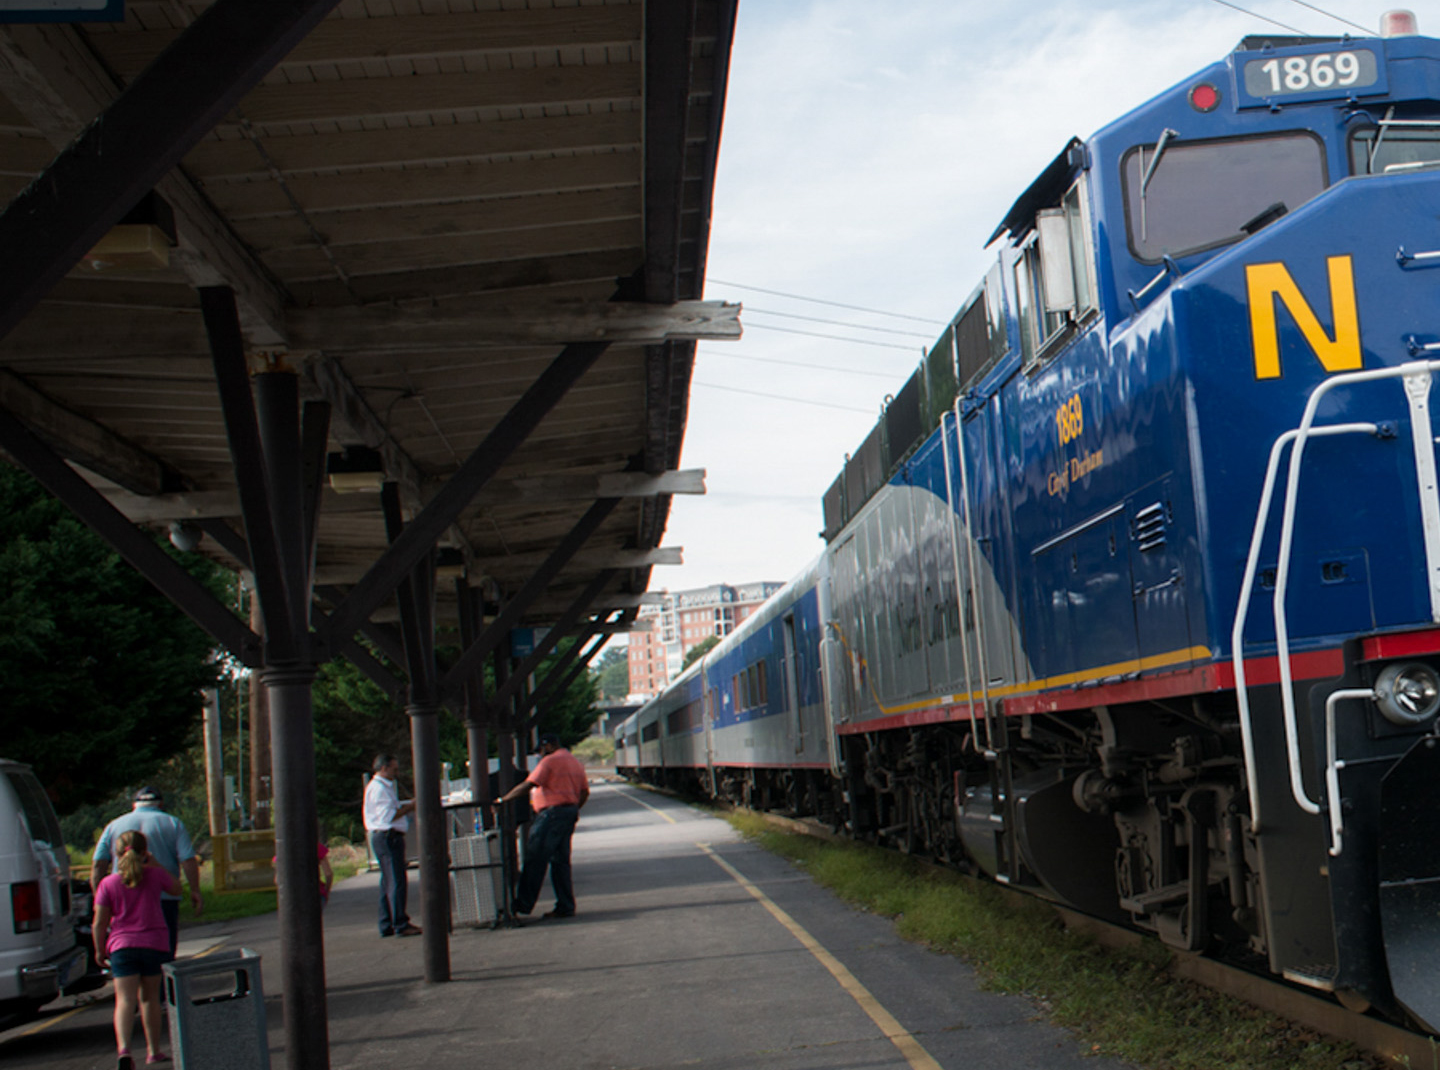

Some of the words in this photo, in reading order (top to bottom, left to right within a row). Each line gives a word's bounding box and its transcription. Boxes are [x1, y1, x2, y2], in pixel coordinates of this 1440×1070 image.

[1261, 51, 1361, 92] 1869
[1244, 254, 1364, 382] N
[1055, 393, 1084, 447] 1869
[1070, 449, 1104, 482] Durham
